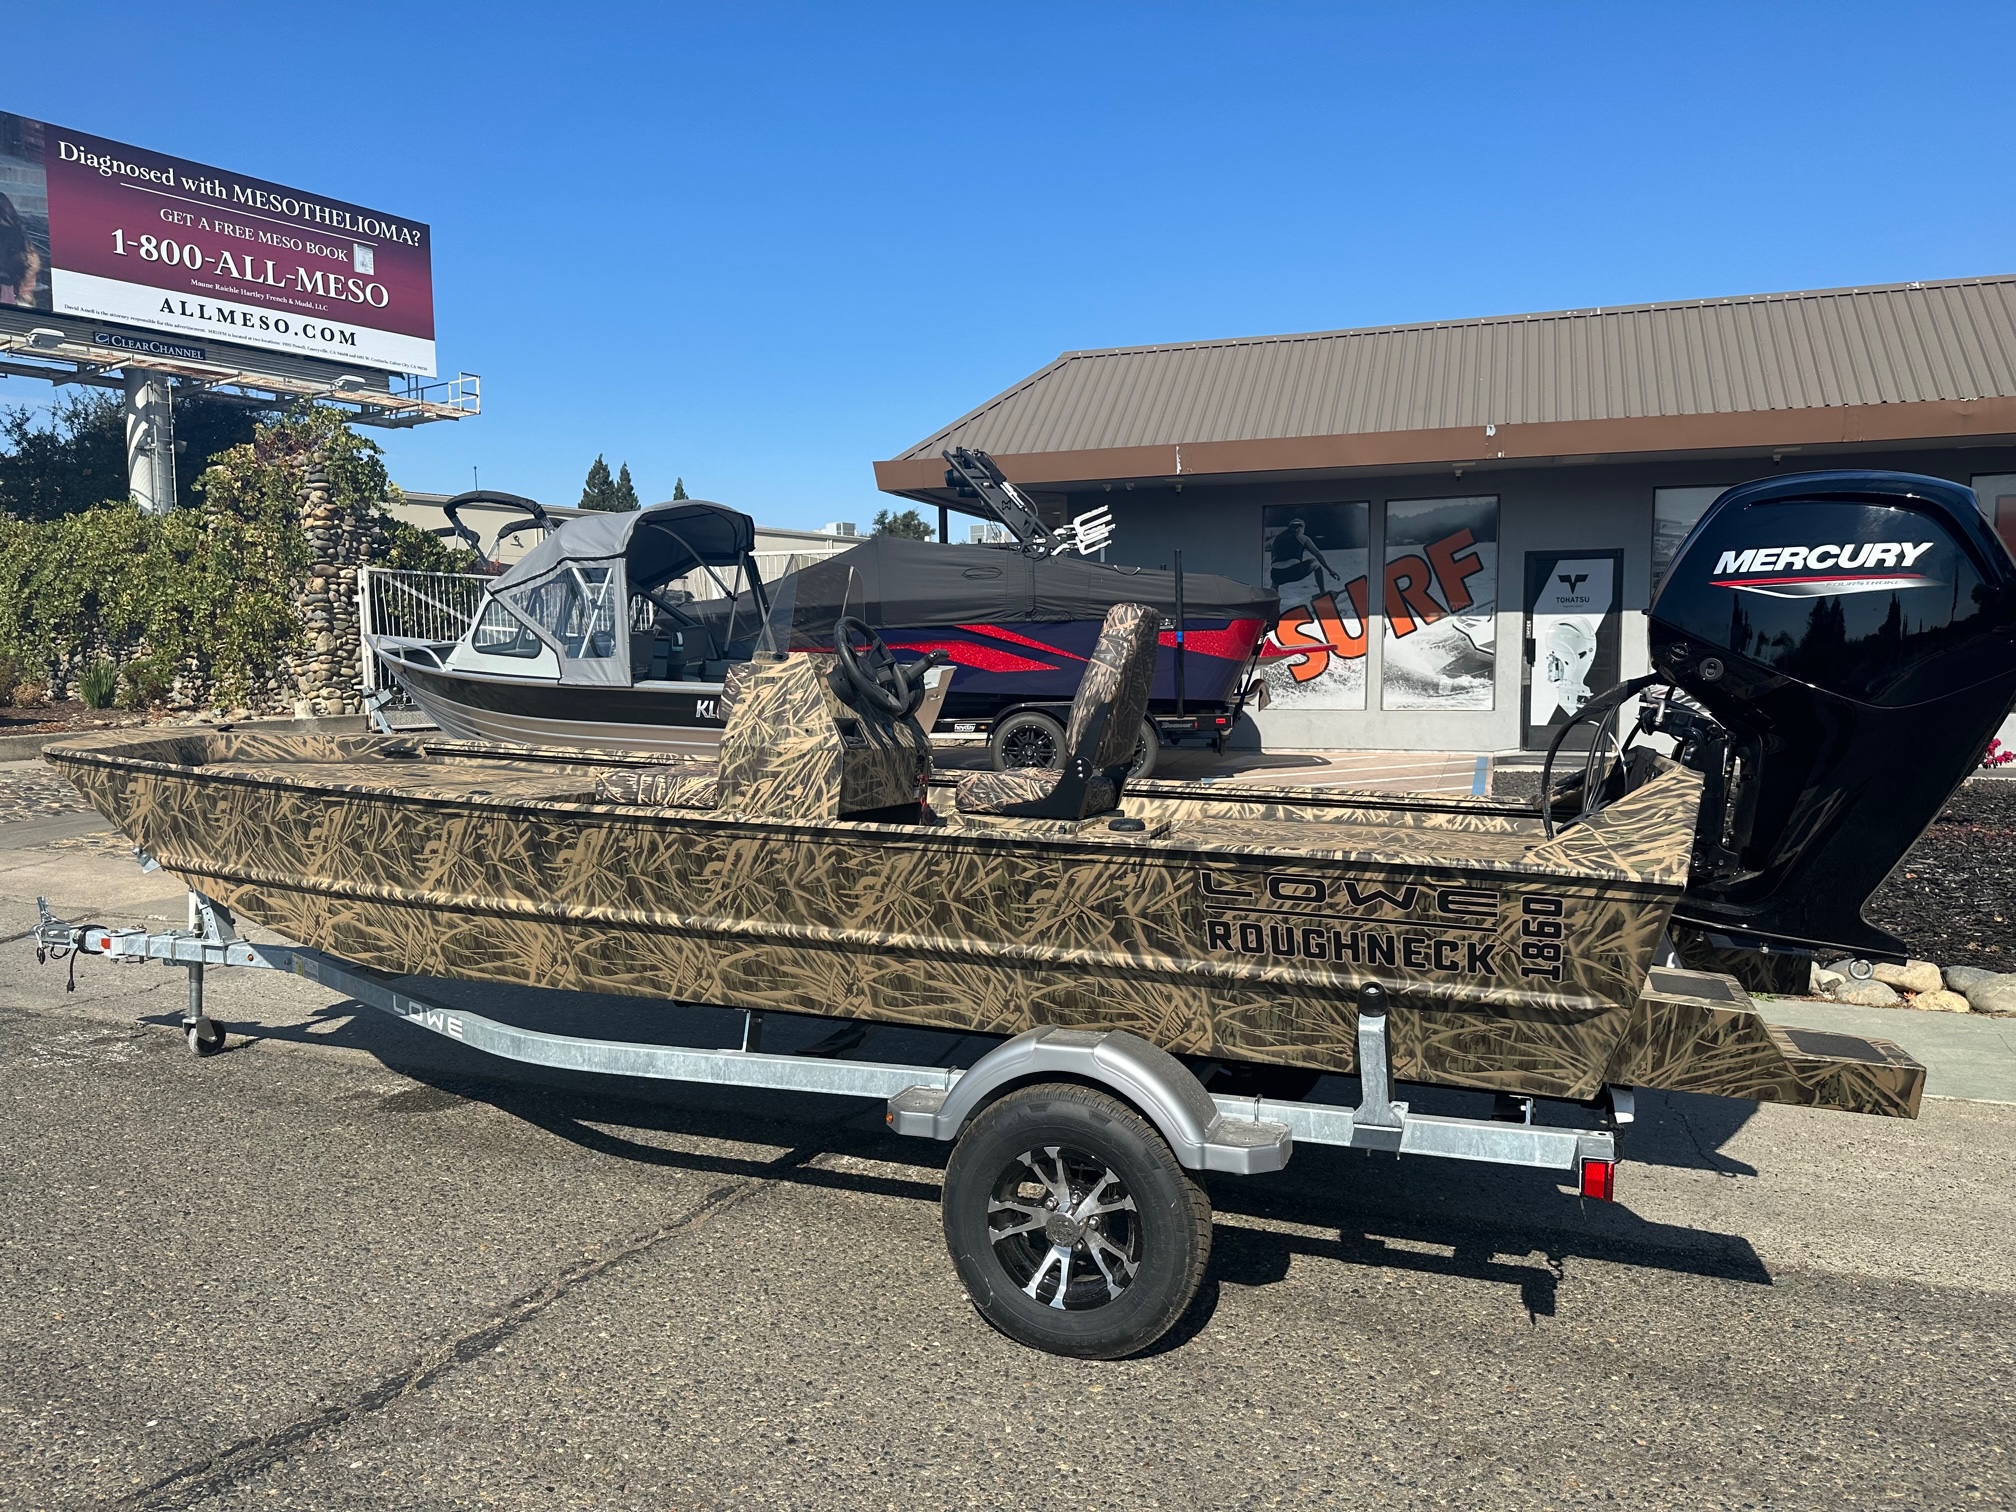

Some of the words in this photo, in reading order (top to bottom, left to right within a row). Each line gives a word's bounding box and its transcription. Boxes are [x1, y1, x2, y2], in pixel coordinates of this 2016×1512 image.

[58, 140, 176, 187] Diagnosed
[180, 175, 227, 200] with
[233, 184, 421, 247] MESOTHELIOMA?
[160, 208, 195, 227] GET
[198, 216, 211, 231] A
[214, 220, 255, 241] FREE
[258, 230, 303, 251] MESO
[306, 241, 349, 262] BOOK
[111, 228, 390, 309] 1-800-ALL-MESO
[190, 278, 213, 290] Maune
[215, 282, 239, 295] Raichle
[240, 288, 265, 301] Hartley
[266, 293, 288, 304] French
[315, 303, 329, 312] LLC
[159, 297, 358, 346] ALLMESO.COM
[1712, 542, 1934, 575] MERCURY
[1276, 528, 1484, 682] SURF
[1555, 596, 1590, 604] TOHATSU
[1823, 579, 1902, 588] FOURSTROKE
[1200, 870, 1500, 919] LOWE
[1206, 918, 1498, 976] ROUGHNECK
[1520, 894, 1566, 982] 1860
[392, 994, 463, 1039] LOWE
